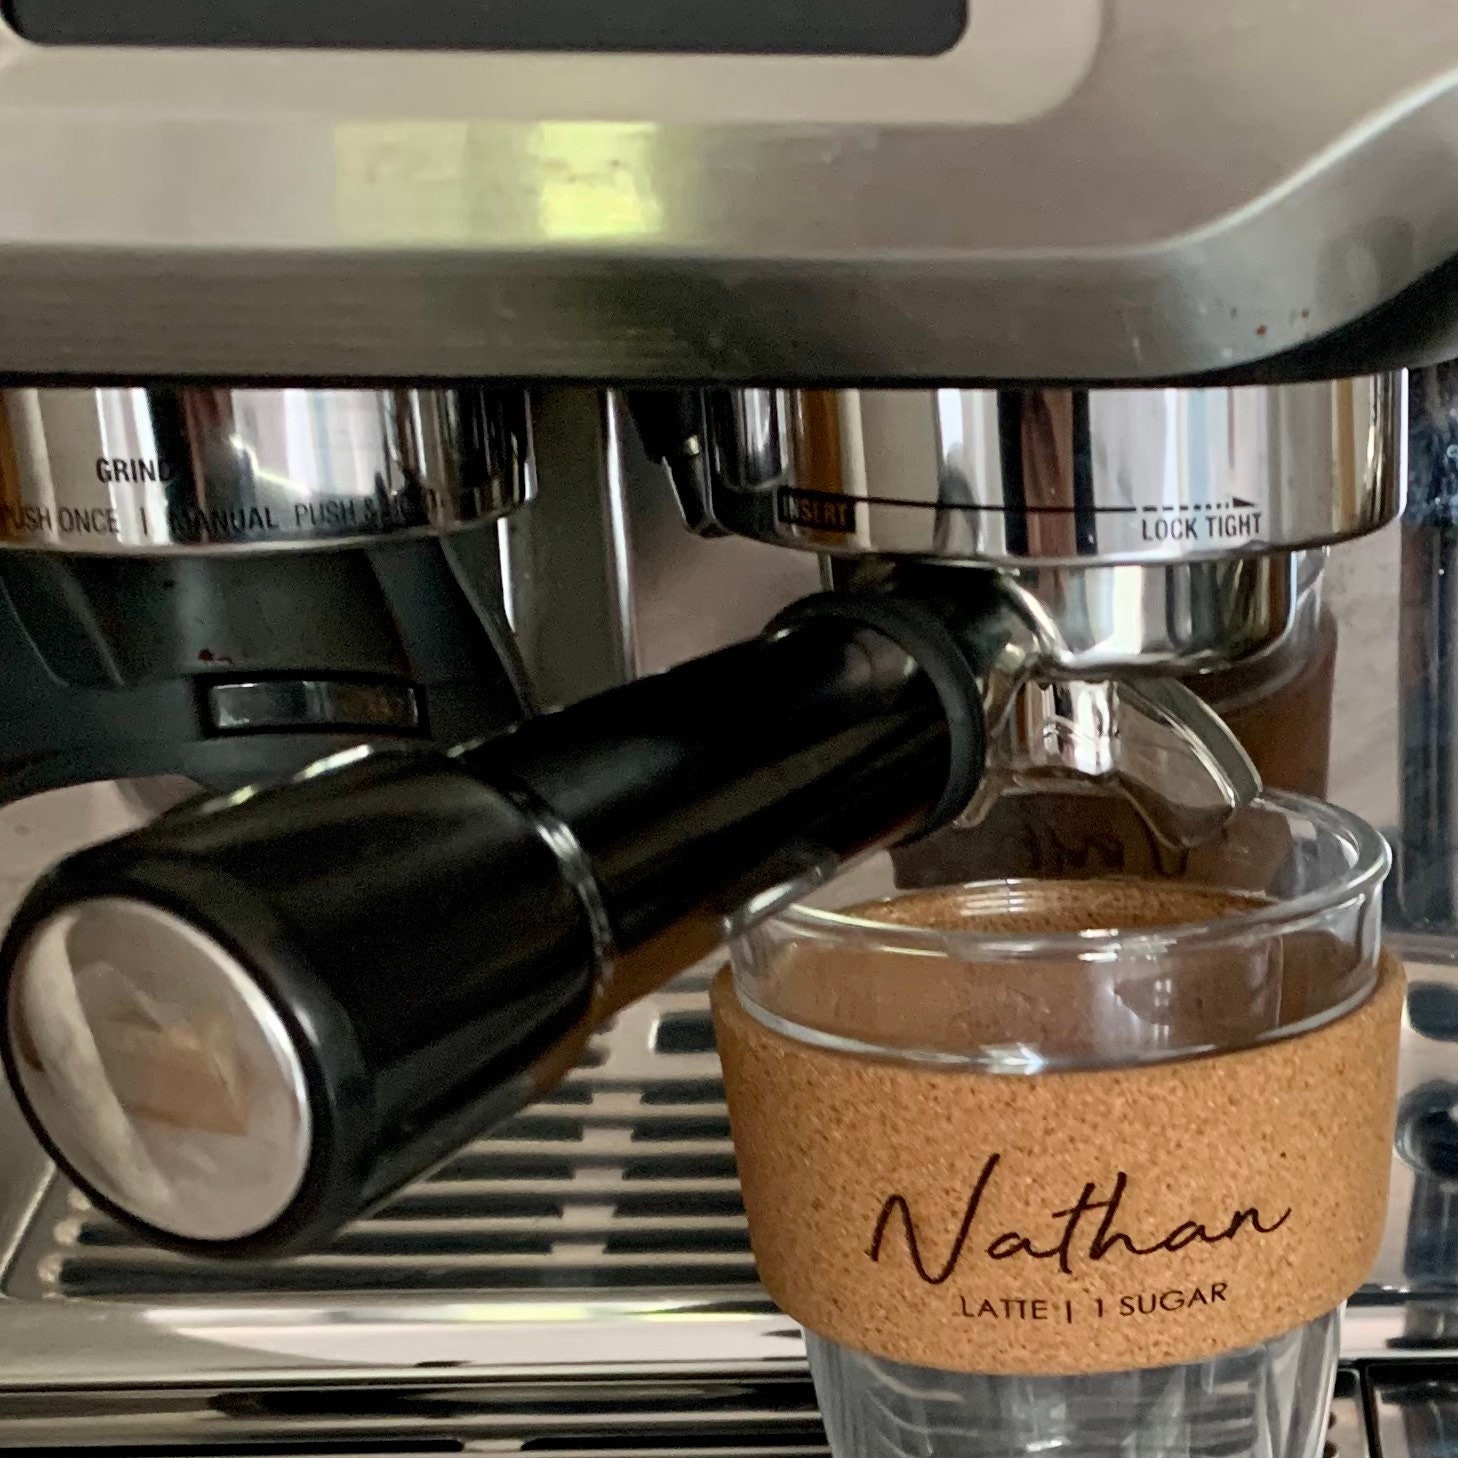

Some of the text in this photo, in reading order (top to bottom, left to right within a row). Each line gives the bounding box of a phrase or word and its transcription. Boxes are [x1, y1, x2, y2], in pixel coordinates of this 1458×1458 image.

[58, 506, 119, 534] ONCE
[295, 499, 356, 527] PUSH
[1142, 512, 1262, 541] LOCK TIGHT
[864, 1152, 1292, 1285] Nathan
[960, 1295, 1048, 1320] LATTE
[1119, 1282, 1228, 1317] SUGAR
